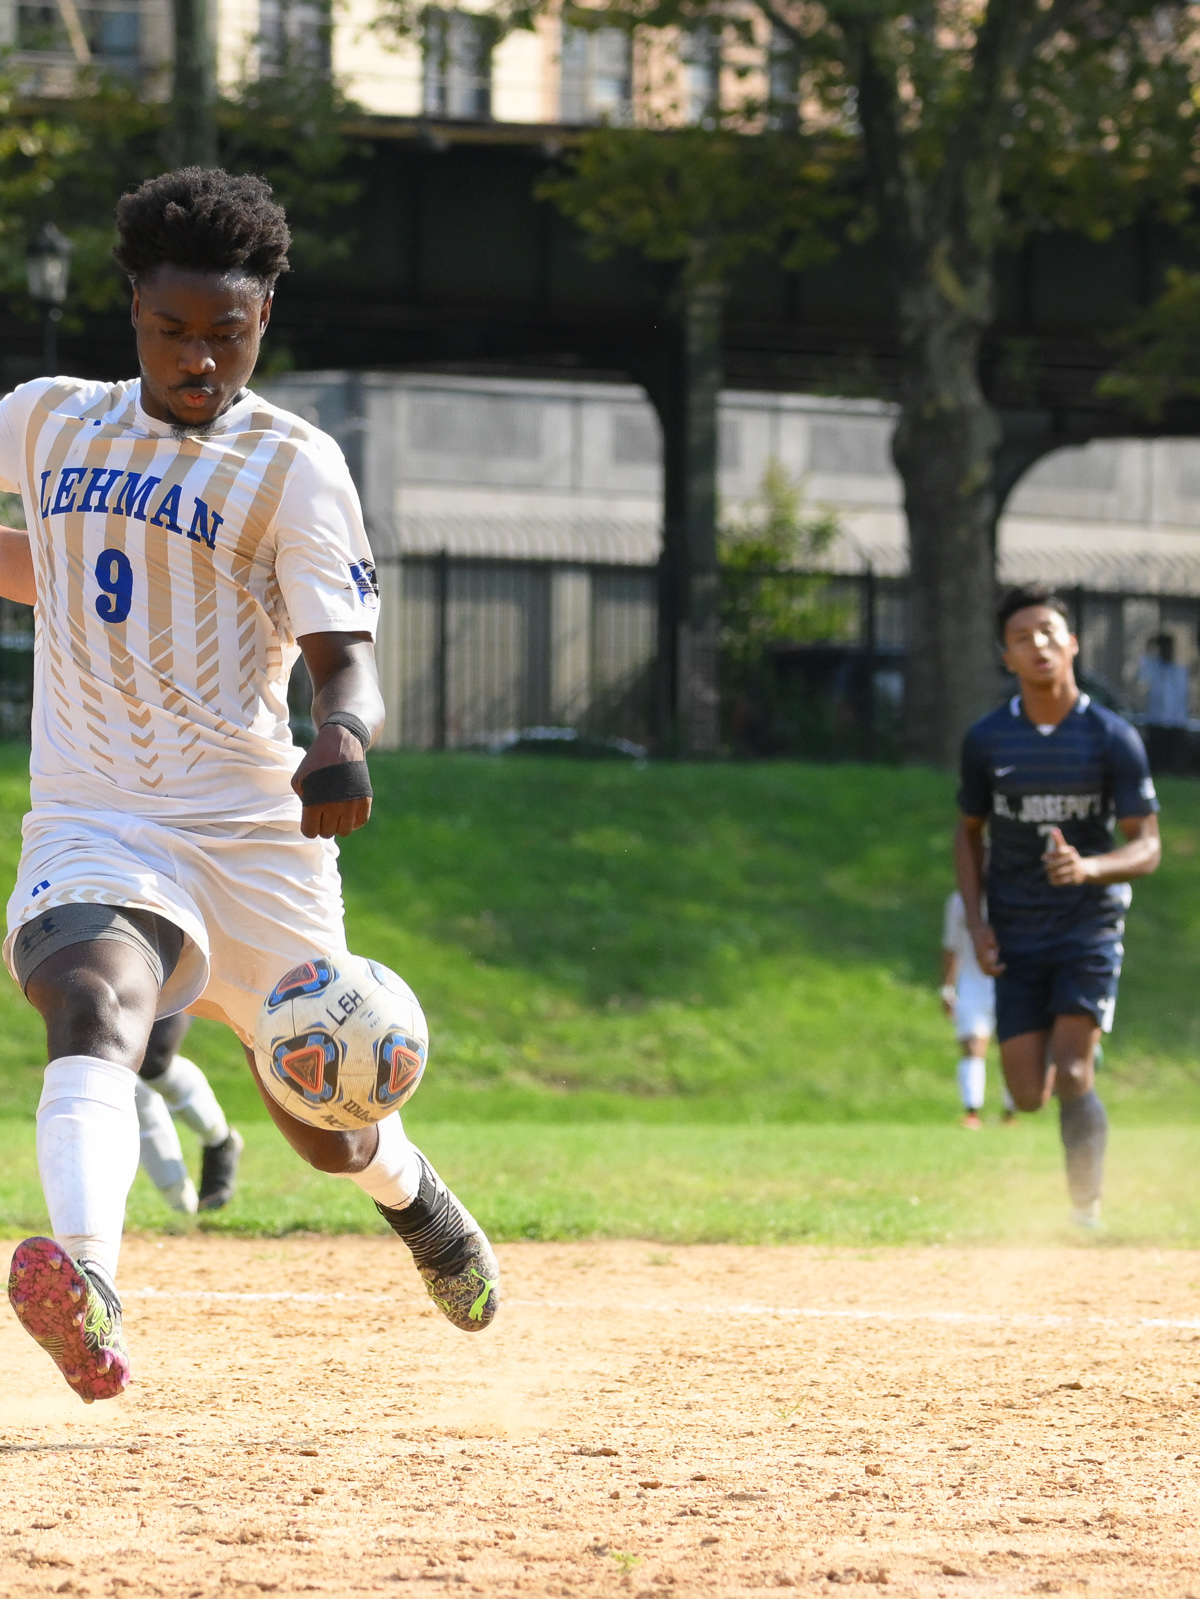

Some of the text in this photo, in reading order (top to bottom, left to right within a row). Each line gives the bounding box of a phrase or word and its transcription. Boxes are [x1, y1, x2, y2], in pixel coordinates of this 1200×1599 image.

[40, 467, 224, 550] LEHMAN
[95, 548, 134, 624] 9
[325, 989, 364, 1027] LEH
